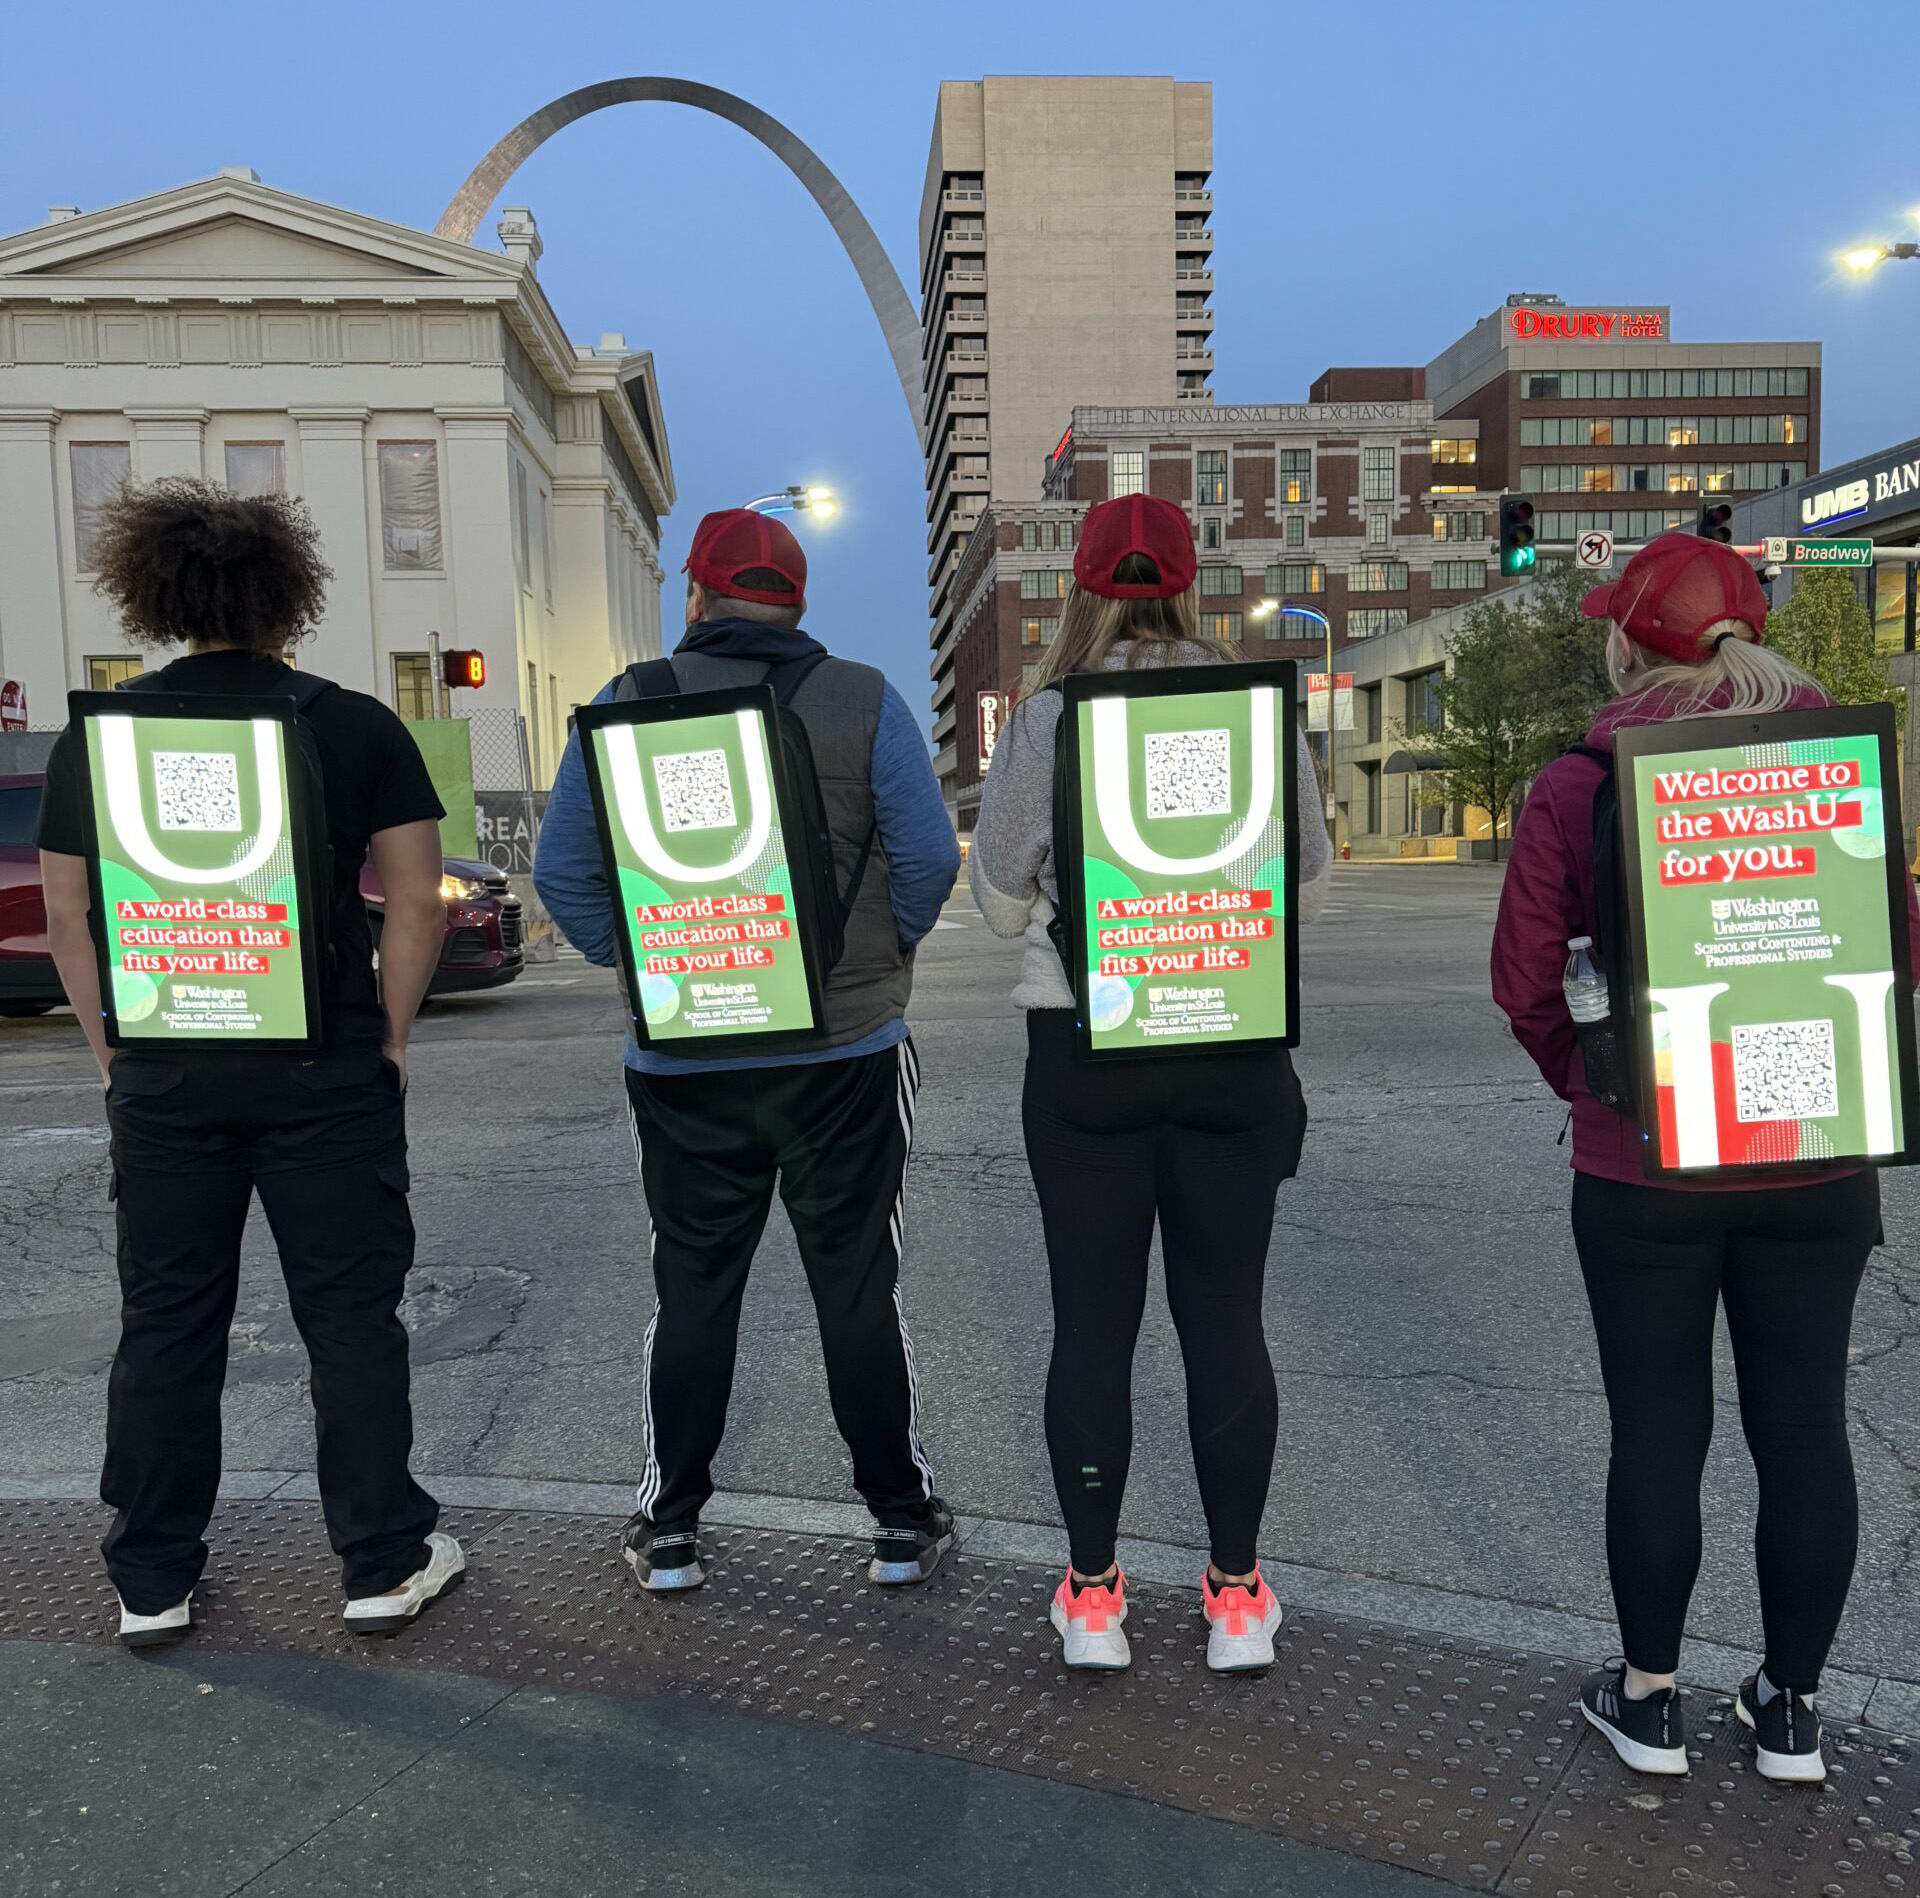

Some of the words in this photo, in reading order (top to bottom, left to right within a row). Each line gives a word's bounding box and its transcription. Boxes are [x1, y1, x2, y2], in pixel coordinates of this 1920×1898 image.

[1510, 307, 1617, 338] DRURY
[1621, 314, 1662, 325] PLAZA
[1621, 326, 1663, 337] HOTEL
[1103, 409, 1134, 424] THE
[1142, 407, 1271, 424] INTERNATIONAL
[1280, 406, 1309, 421] FUR
[1320, 405, 1405, 420] EXCHANGE
[1802, 479, 1869, 524] UMB
[1795, 544, 1870, 563] Broadway
[470, 657, 482, 681] 8
[1656, 767, 1809, 799] Welcome
[1818, 763, 1851, 786] to
[1661, 810, 1713, 839] the
[1717, 792, 1840, 833] WashU
[1663, 849, 1712, 878] for
[1717, 844, 1804, 883] you.
[119, 899, 138, 918] A
[141, 898, 267, 919] world-class
[640, 904, 655, 921] A
[657, 894, 767, 920] world-class
[1100, 898, 1118, 917] A
[1122, 889, 1251, 916] world-class
[1730, 897, 1819, 916] Washington
[123, 924, 233, 946] education
[239, 926, 283, 946] that
[643, 923, 740, 947] education
[744, 919, 784, 938] that
[1101, 920, 1215, 946] education
[1221, 916, 1266, 938] that
[1713, 921, 1768, 934] University
[1768, 919, 1778, 931] in
[1791, 914, 1821, 928] Louis
[125, 951, 160, 969] fits
[165, 956, 218, 975] your
[223, 951, 265, 970] life.
[648, 954, 679, 972] fits
[682, 952, 728, 974] your
[731, 945, 770, 966] life.
[1102, 953, 1138, 974] fits
[1142, 953, 1198, 976] your
[1202, 945, 1246, 967] life.
[1820, 1734, 1903, 1758] OUNDRY
